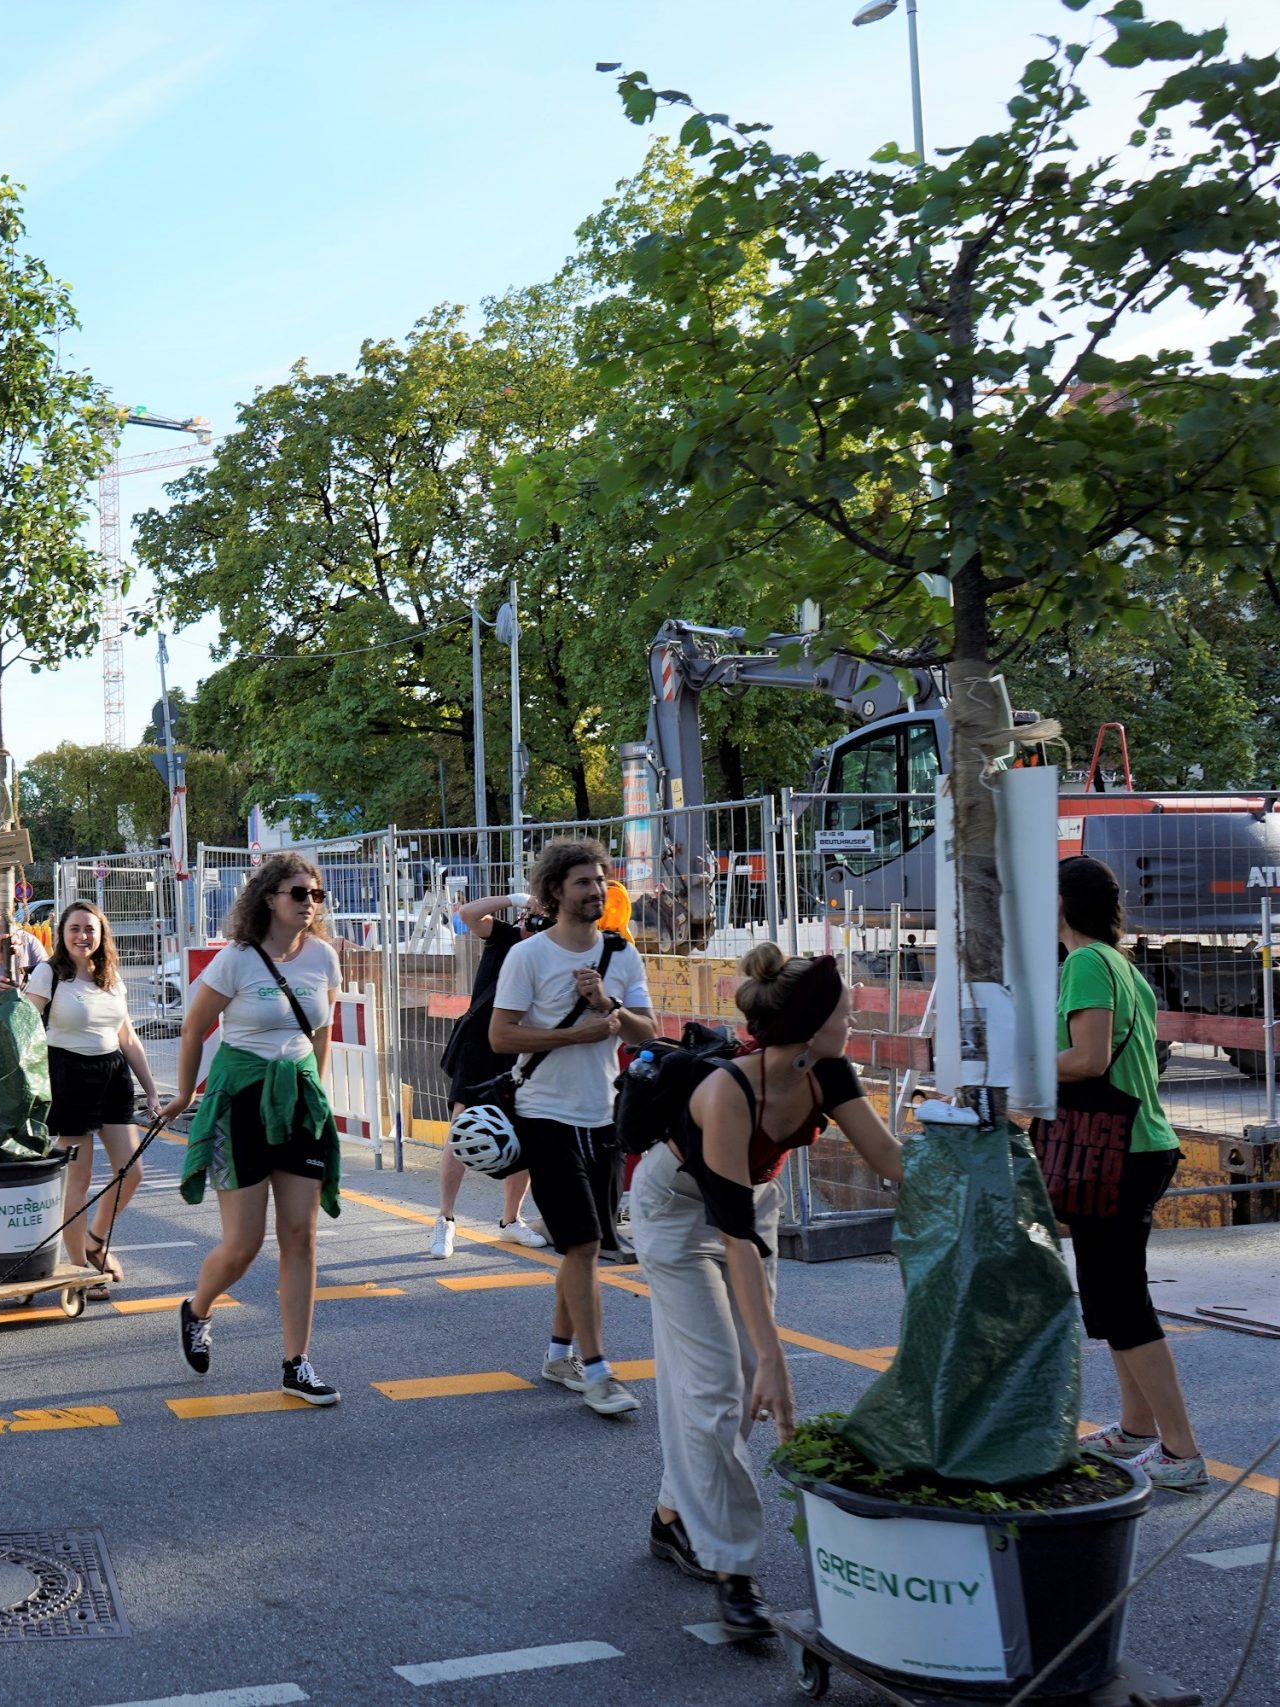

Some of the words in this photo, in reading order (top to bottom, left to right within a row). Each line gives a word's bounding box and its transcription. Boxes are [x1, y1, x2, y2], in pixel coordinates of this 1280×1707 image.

[1044, 1174, 1120, 1218] BLIC
[7, 1214, 44, 1228] ALLEE
[816, 1547, 900, 1598] GREEN
[904, 1575, 980, 1606] CITY
